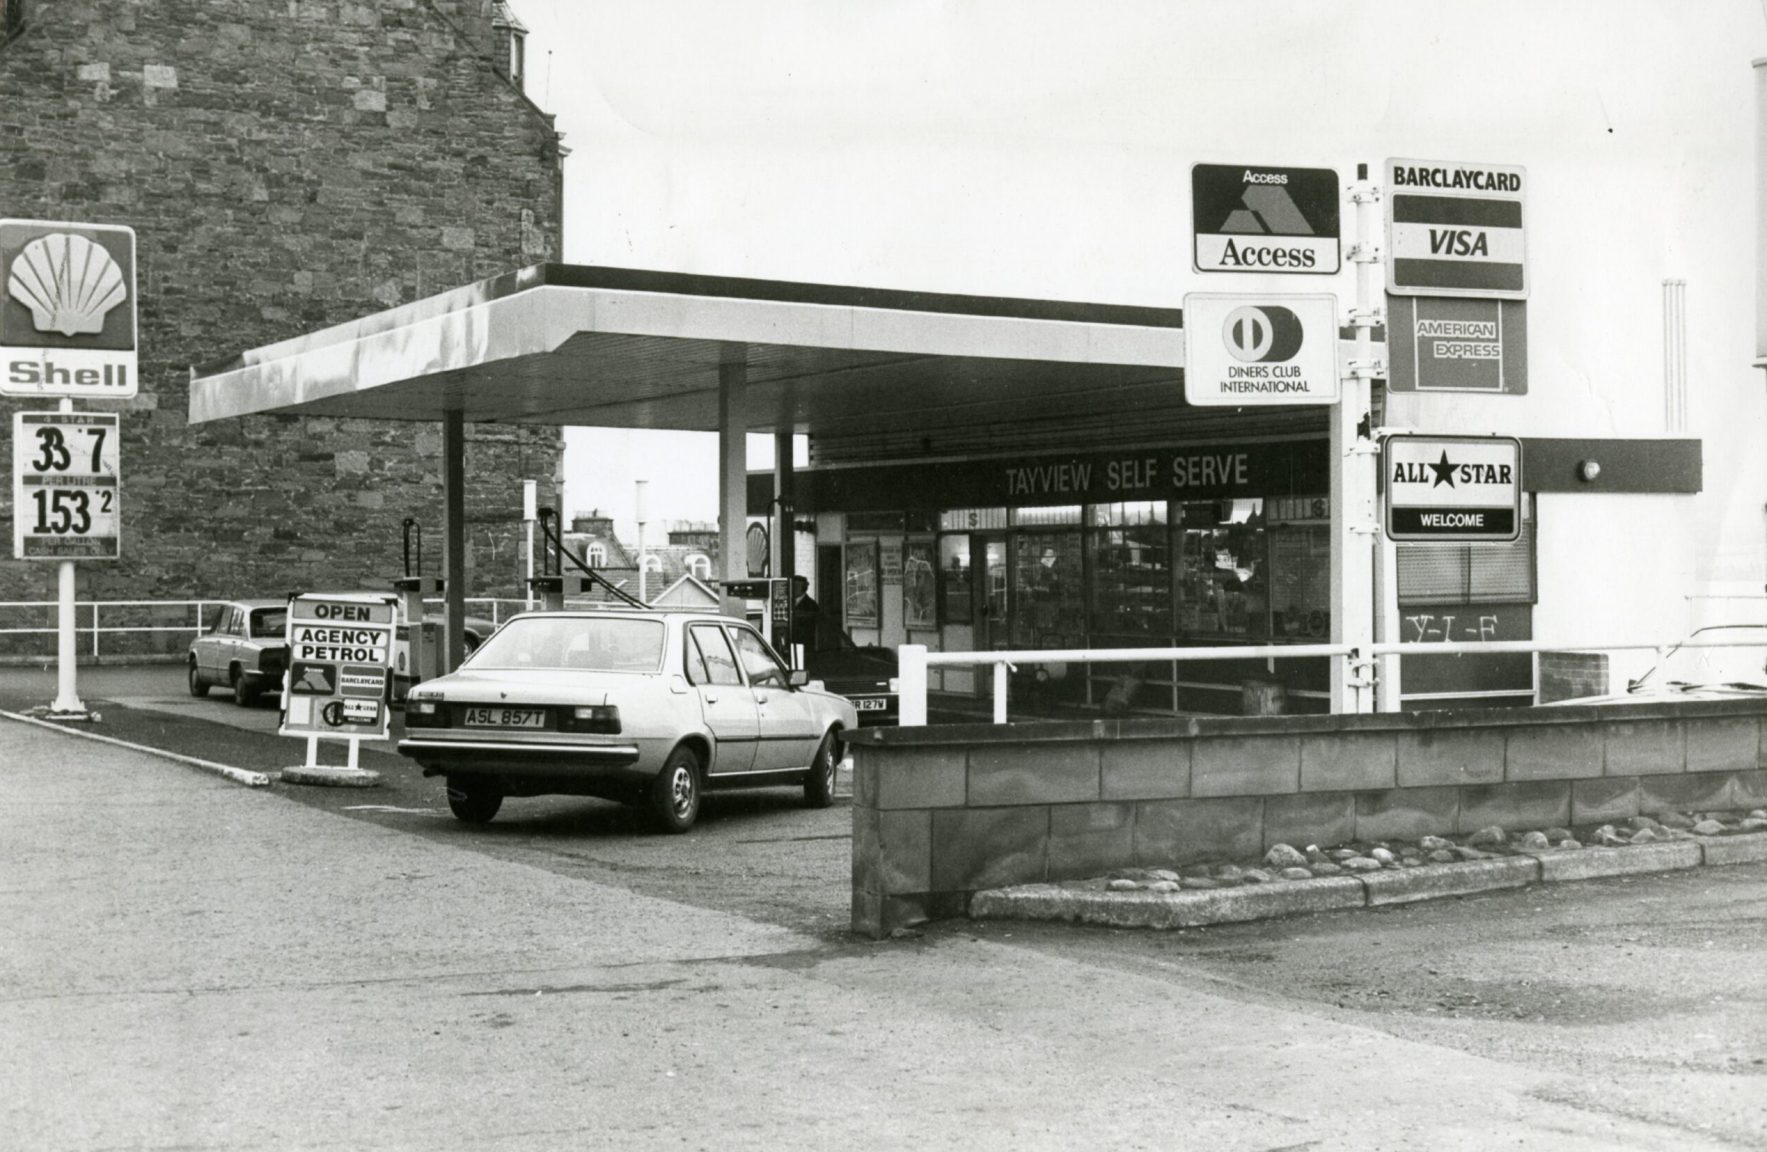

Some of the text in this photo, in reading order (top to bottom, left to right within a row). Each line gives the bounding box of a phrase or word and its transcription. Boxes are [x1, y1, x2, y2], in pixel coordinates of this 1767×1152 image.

[1242, 169, 1288, 184] Access
[1393, 166, 1521, 192] BARCLAYCARD
[1429, 229, 1489, 256] VISA
[1219, 237, 1316, 268] Access
[1416, 321, 1495, 336] AMERICAN
[1435, 343, 1500, 357] EXPRESS
[8, 360, 128, 387] Shell
[1228, 365, 1302, 379] DINERS CLUB
[1220, 380, 1310, 393] INTERNATIONAL
[1006, 454, 1249, 495] TAYVIEW SELF SERVE
[1393, 462, 1513, 484] ALL STAR
[1420, 513, 1484, 527] WELCOME
[314, 604, 371, 621] OPEN
[301, 629, 381, 645] AGENCY
[302, 646, 379, 662] PETROL
[341, 676, 384, 685] BARCLAYCARD
[466, 709, 544, 725] ASL 857T
